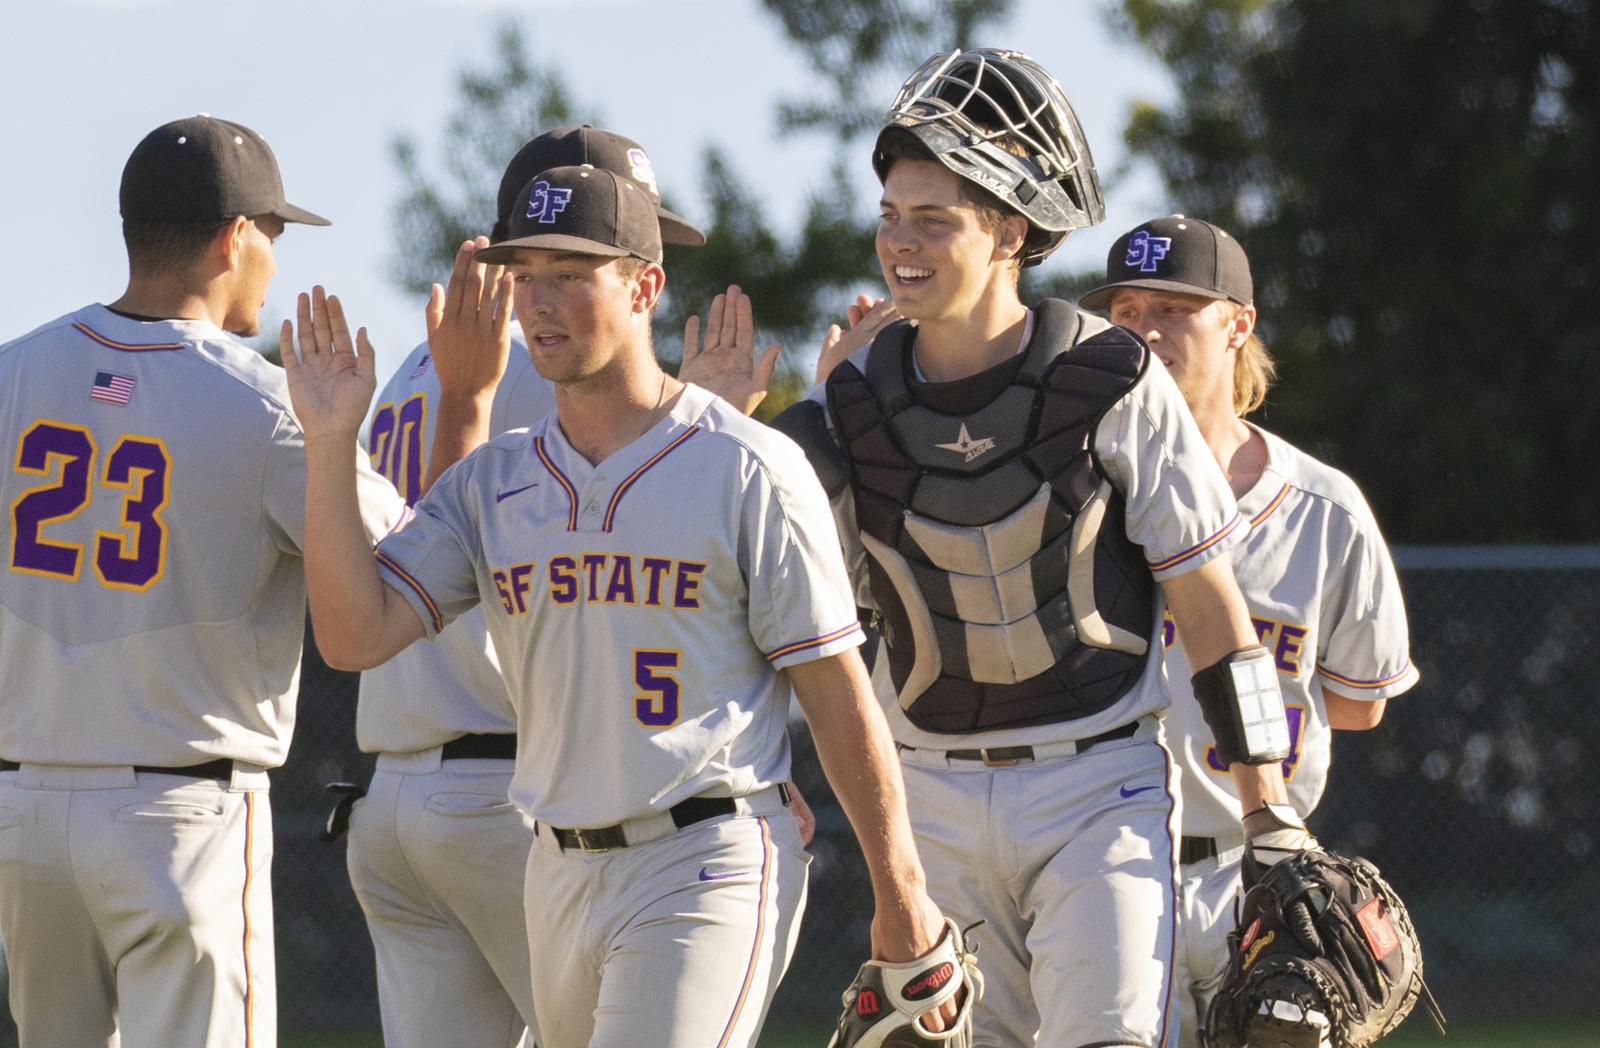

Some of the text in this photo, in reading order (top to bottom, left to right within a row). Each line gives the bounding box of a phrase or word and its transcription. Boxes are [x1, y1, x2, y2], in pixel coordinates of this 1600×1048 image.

[526, 180, 572, 224] SF
[1125, 230, 1172, 272] SF
[9, 417, 173, 592] 23
[491, 551, 707, 619] SF STATE
[632, 647, 682, 729] 5
